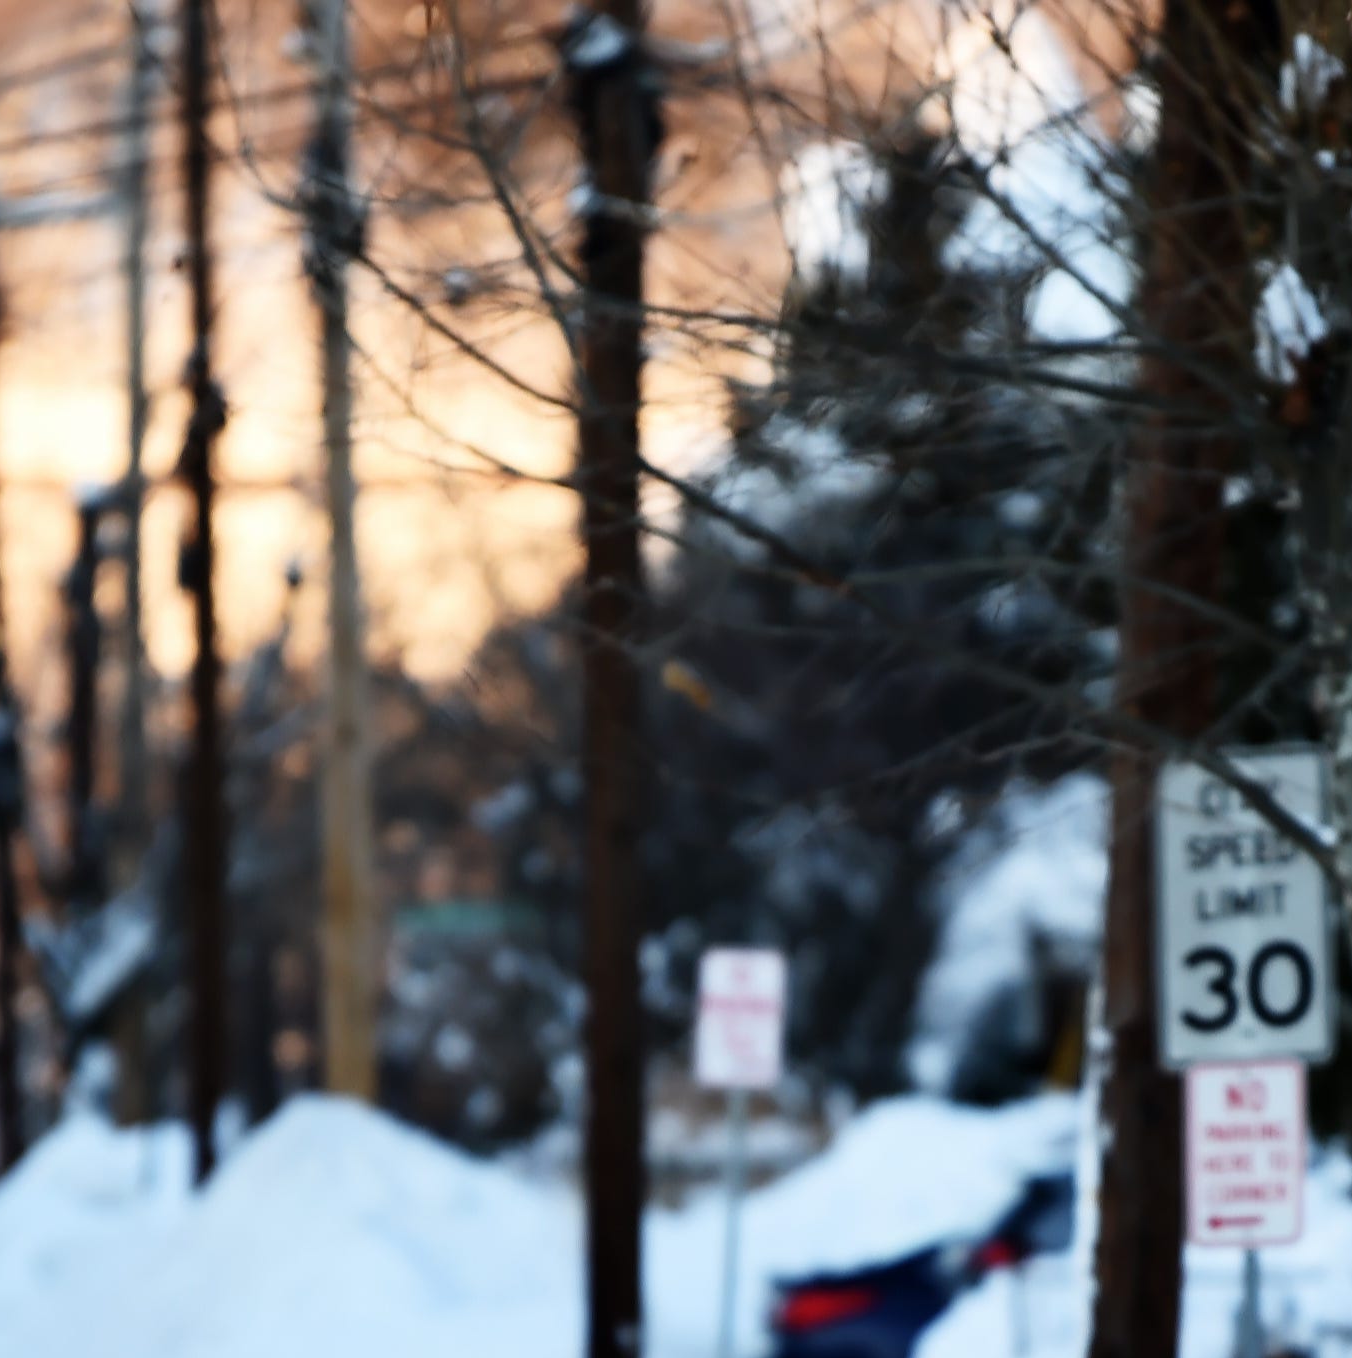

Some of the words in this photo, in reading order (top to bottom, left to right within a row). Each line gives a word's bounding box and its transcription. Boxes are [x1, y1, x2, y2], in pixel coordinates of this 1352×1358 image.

[1187, 829, 1296, 871] SPEED
[1196, 881, 1285, 920] LIMIT
[1181, 938, 1314, 1034] 30
